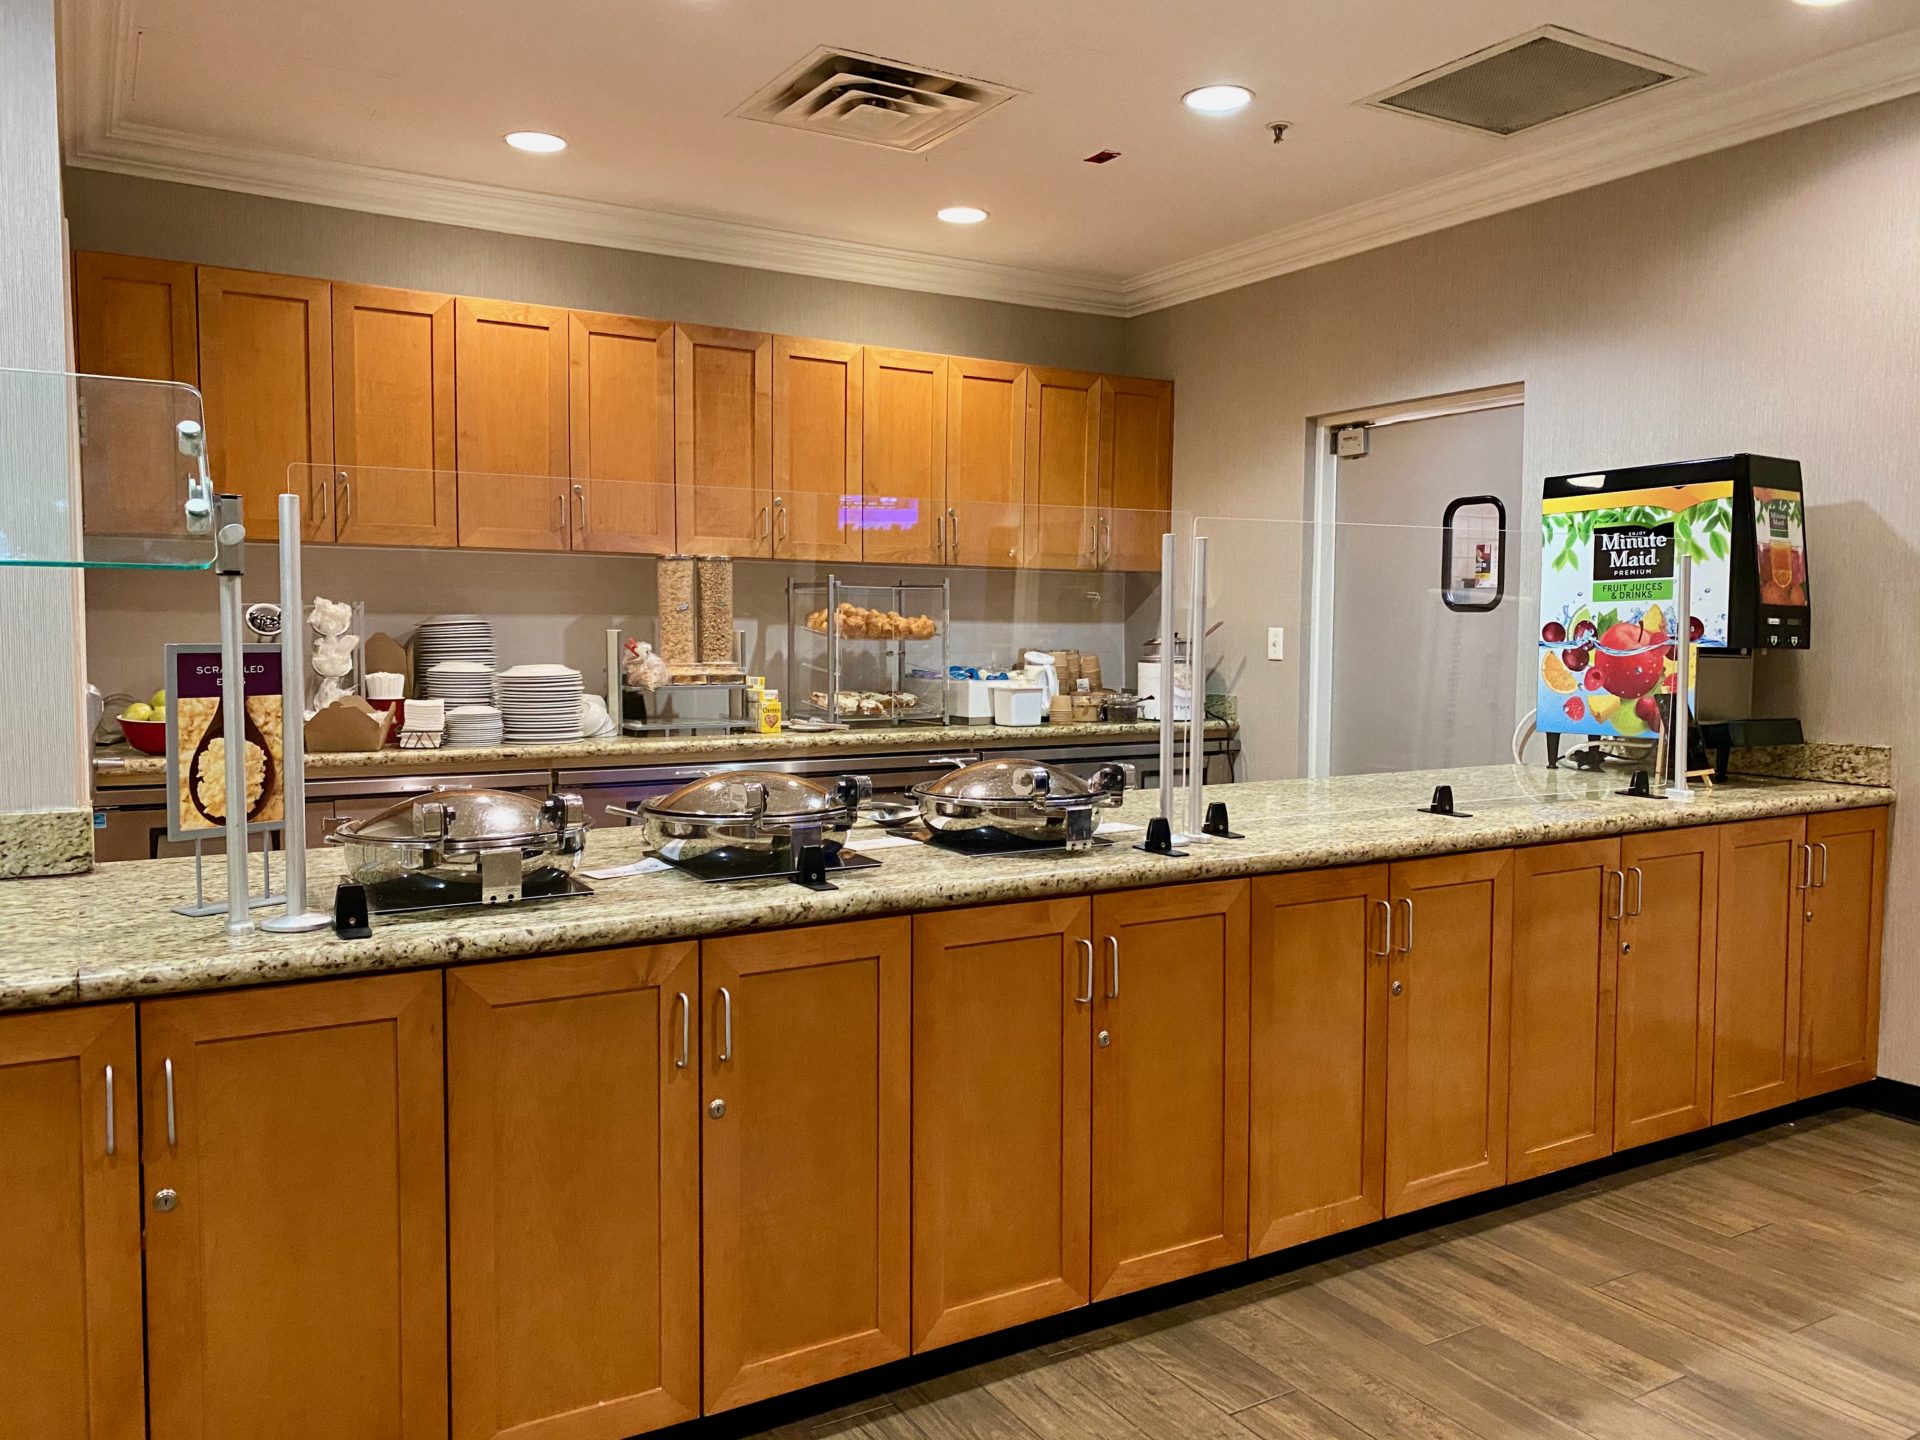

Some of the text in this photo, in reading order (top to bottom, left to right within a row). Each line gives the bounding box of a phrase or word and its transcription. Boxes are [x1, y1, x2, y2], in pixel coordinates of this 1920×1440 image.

[1601, 532, 1667, 551] Minute
[1609, 548, 1658, 568] Maid
[1602, 582, 1663, 592] FRUIT JUICES
[1620, 591, 1652, 599] DRINKS
[196, 665, 265, 674] SCRLED
